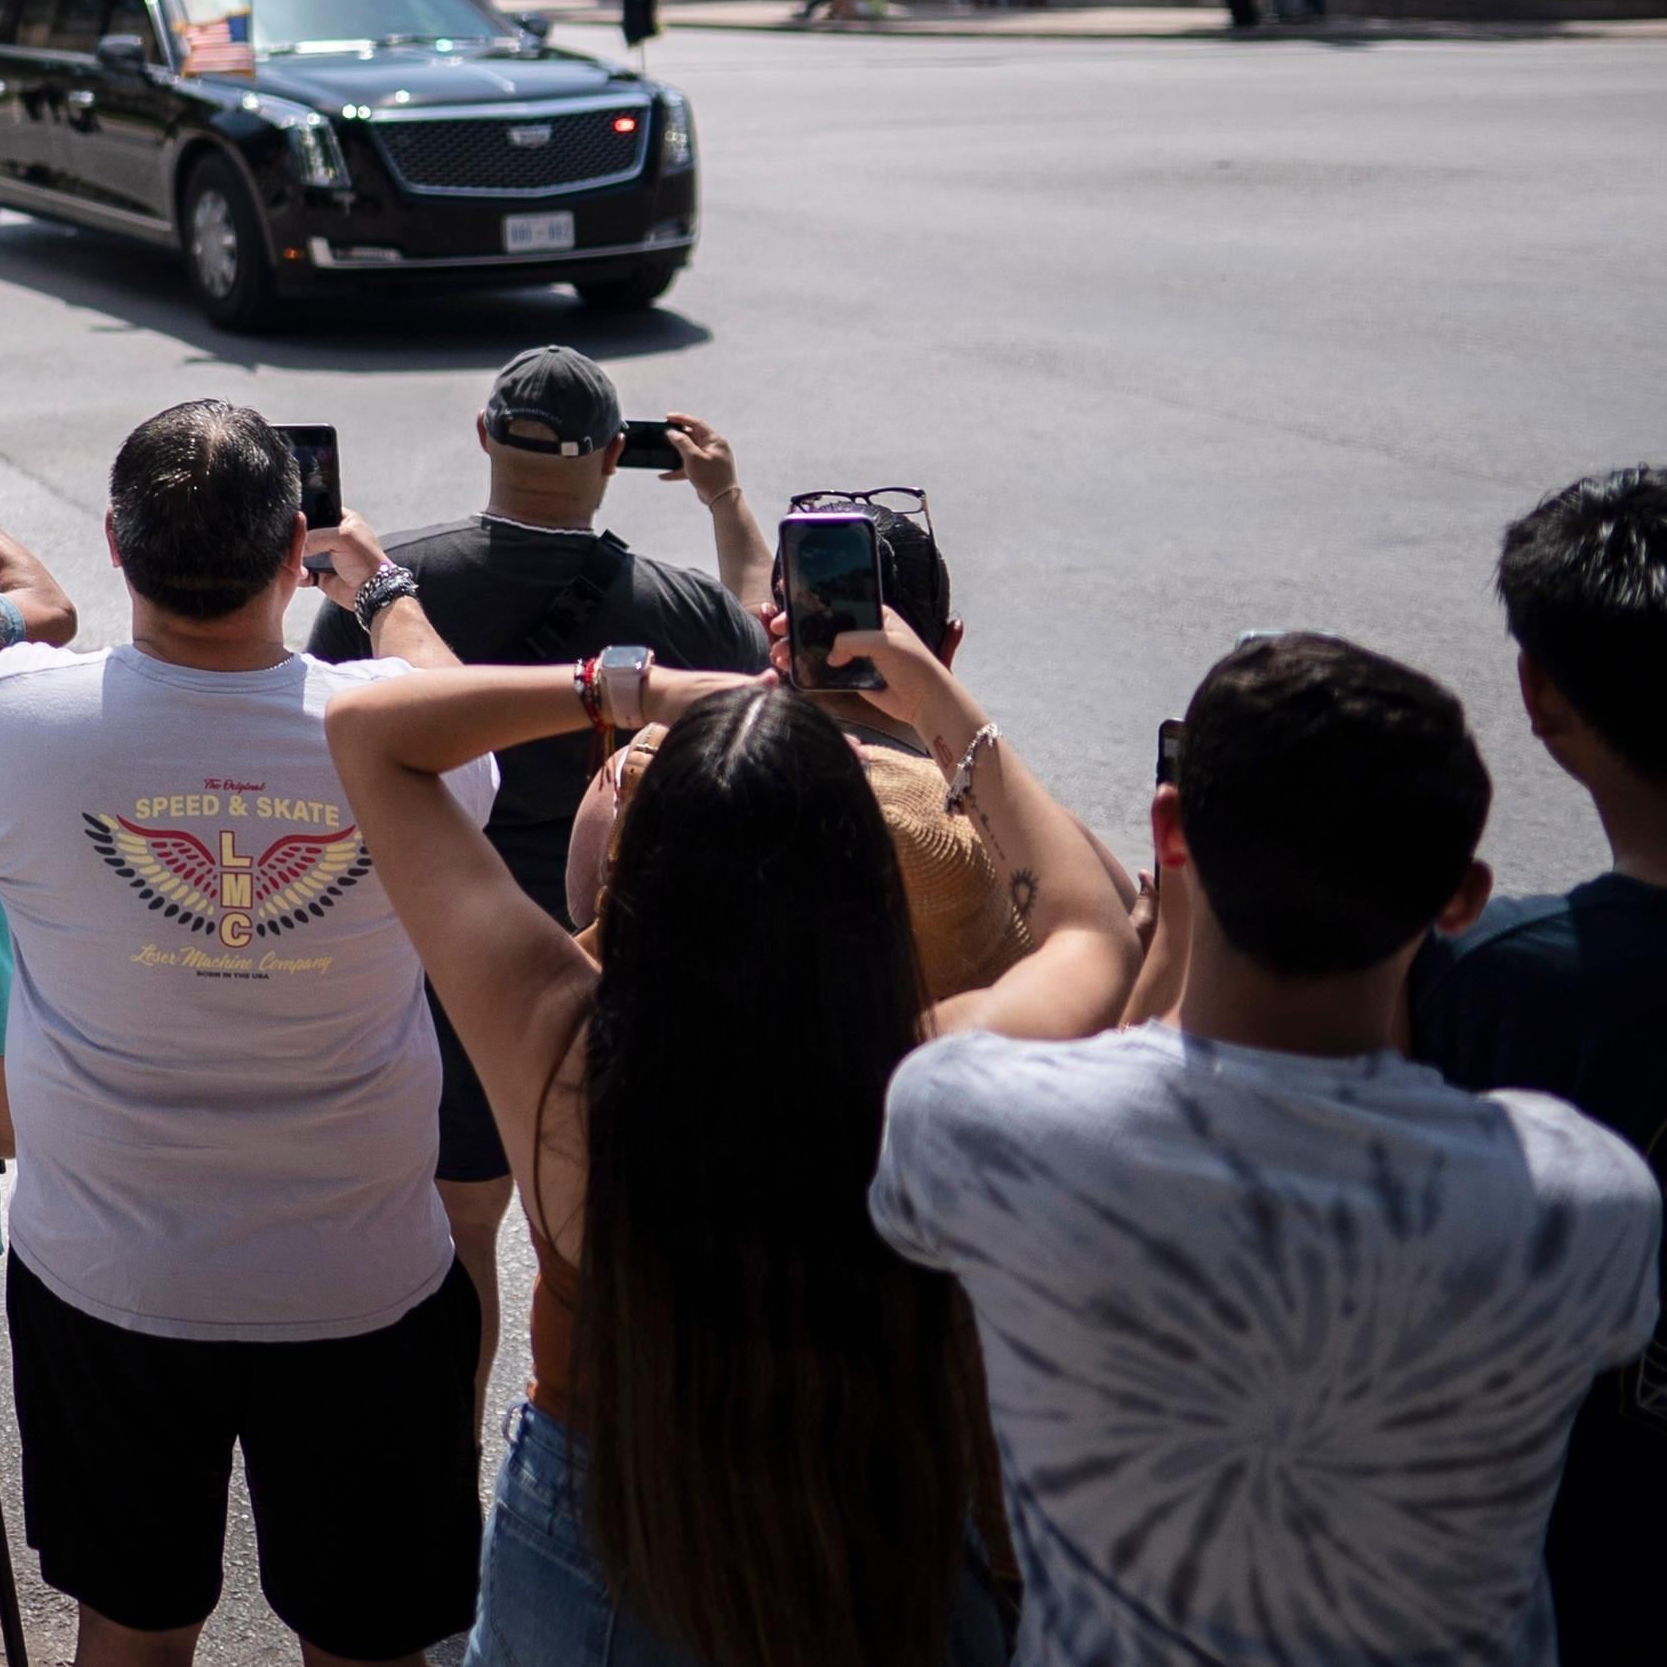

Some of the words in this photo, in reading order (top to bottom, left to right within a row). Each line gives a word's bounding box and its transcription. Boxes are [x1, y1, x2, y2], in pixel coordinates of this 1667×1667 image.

[203, 777, 222, 790] The
[223, 778, 266, 794] Original
[134, 795, 220, 820] SPEED
[228, 794, 249, 817] &
[256, 797, 340, 827] SKATE
[129, 943, 177, 968] Loser
[179, 946, 253, 970] Machine
[259, 949, 333, 974] Company
[234, 971, 250, 979] THE
